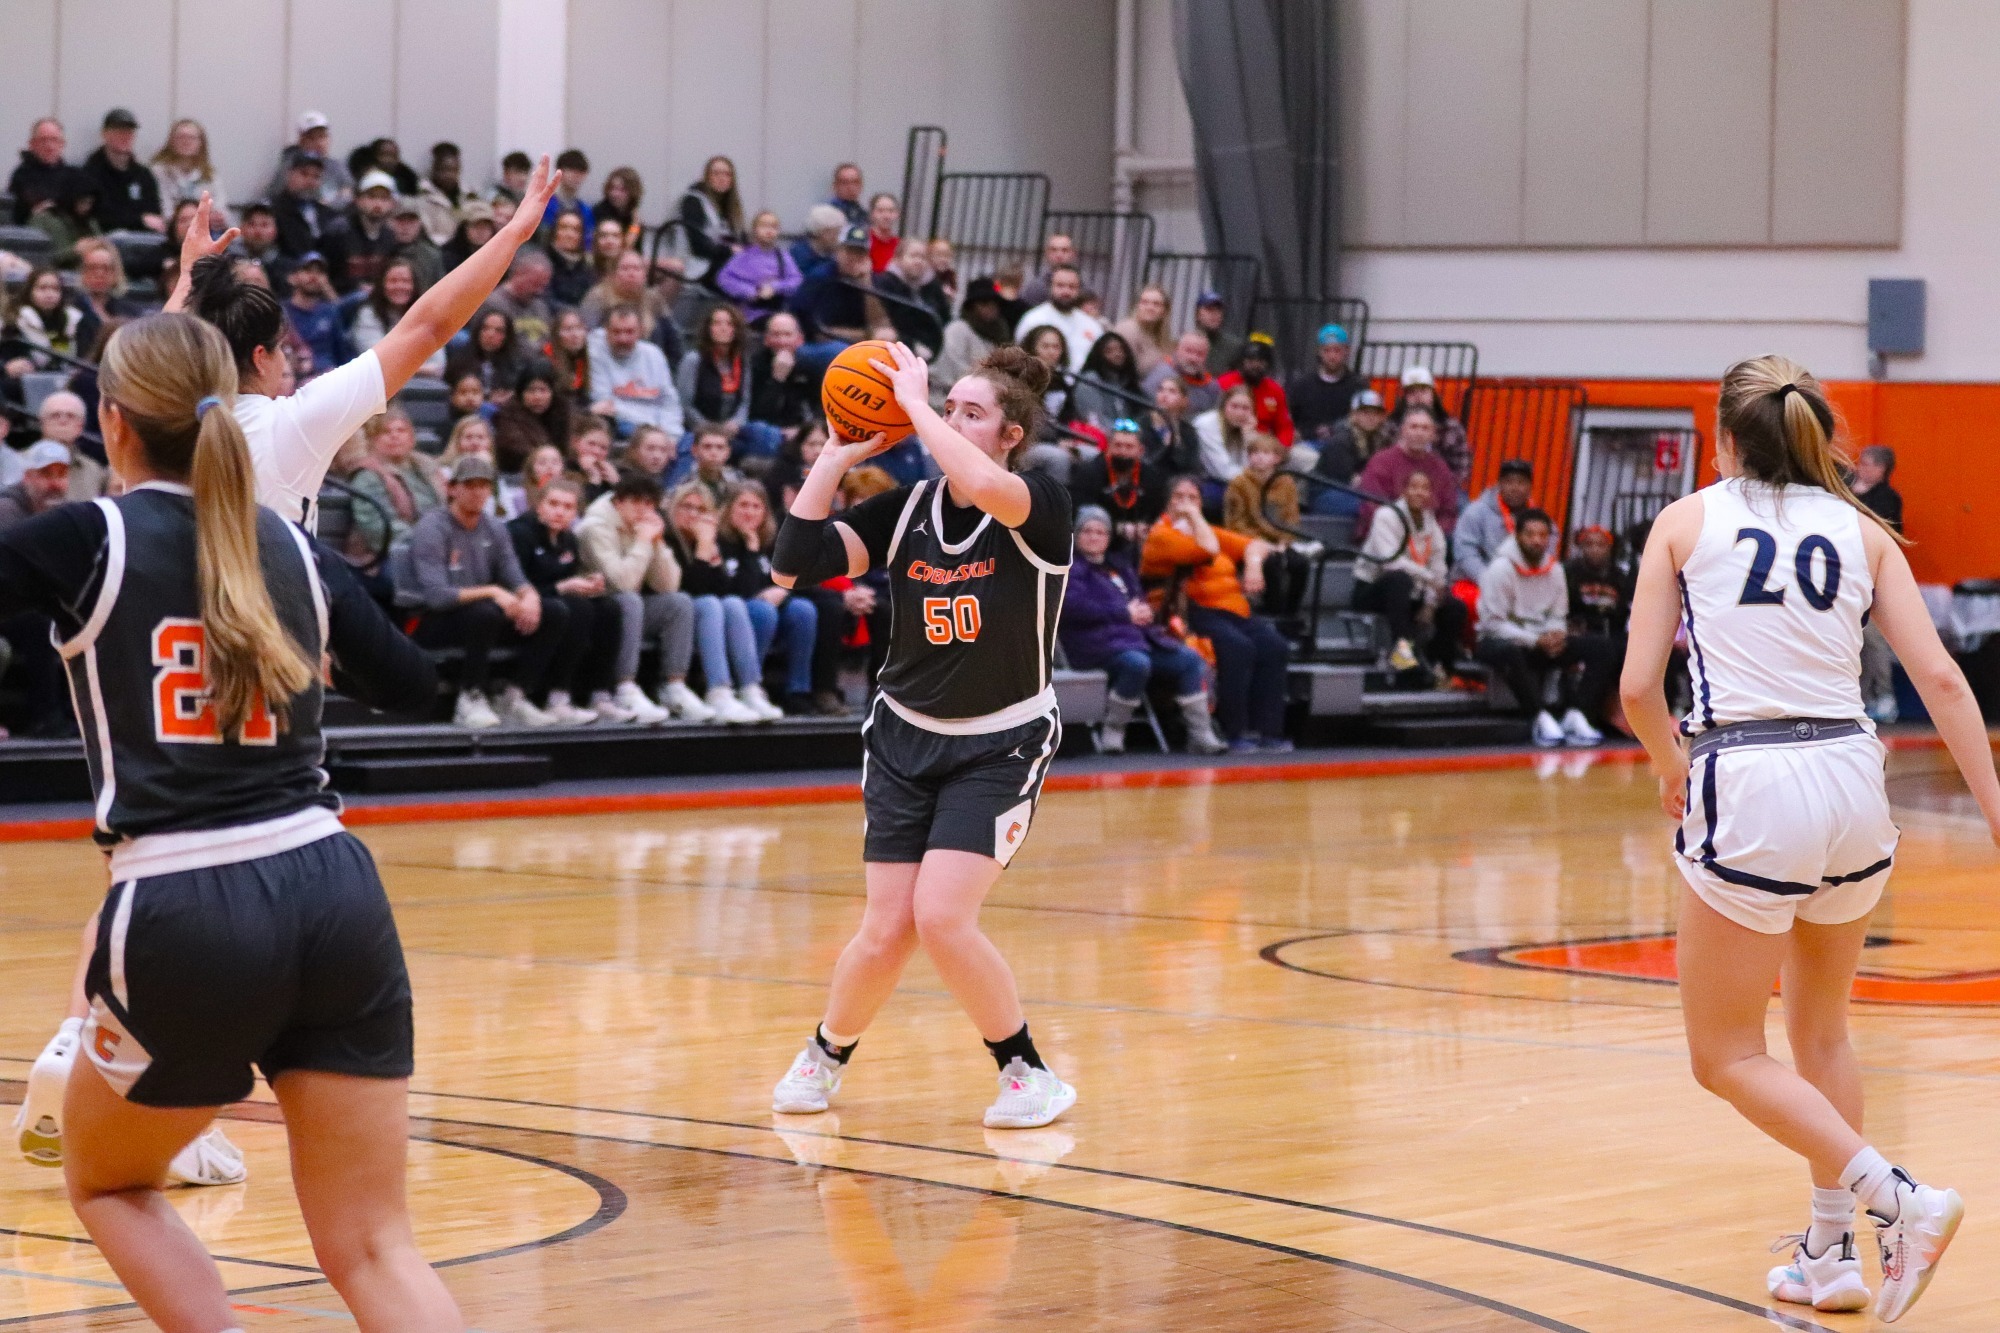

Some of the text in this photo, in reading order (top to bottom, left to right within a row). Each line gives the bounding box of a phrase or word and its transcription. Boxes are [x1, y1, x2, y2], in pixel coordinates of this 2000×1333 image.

[843, 384, 886, 411] EVO
[1733, 527, 1842, 613] 20
[924, 595, 981, 644] 50
[1006, 821, 1022, 844] C
[95, 1026, 121, 1063] C
